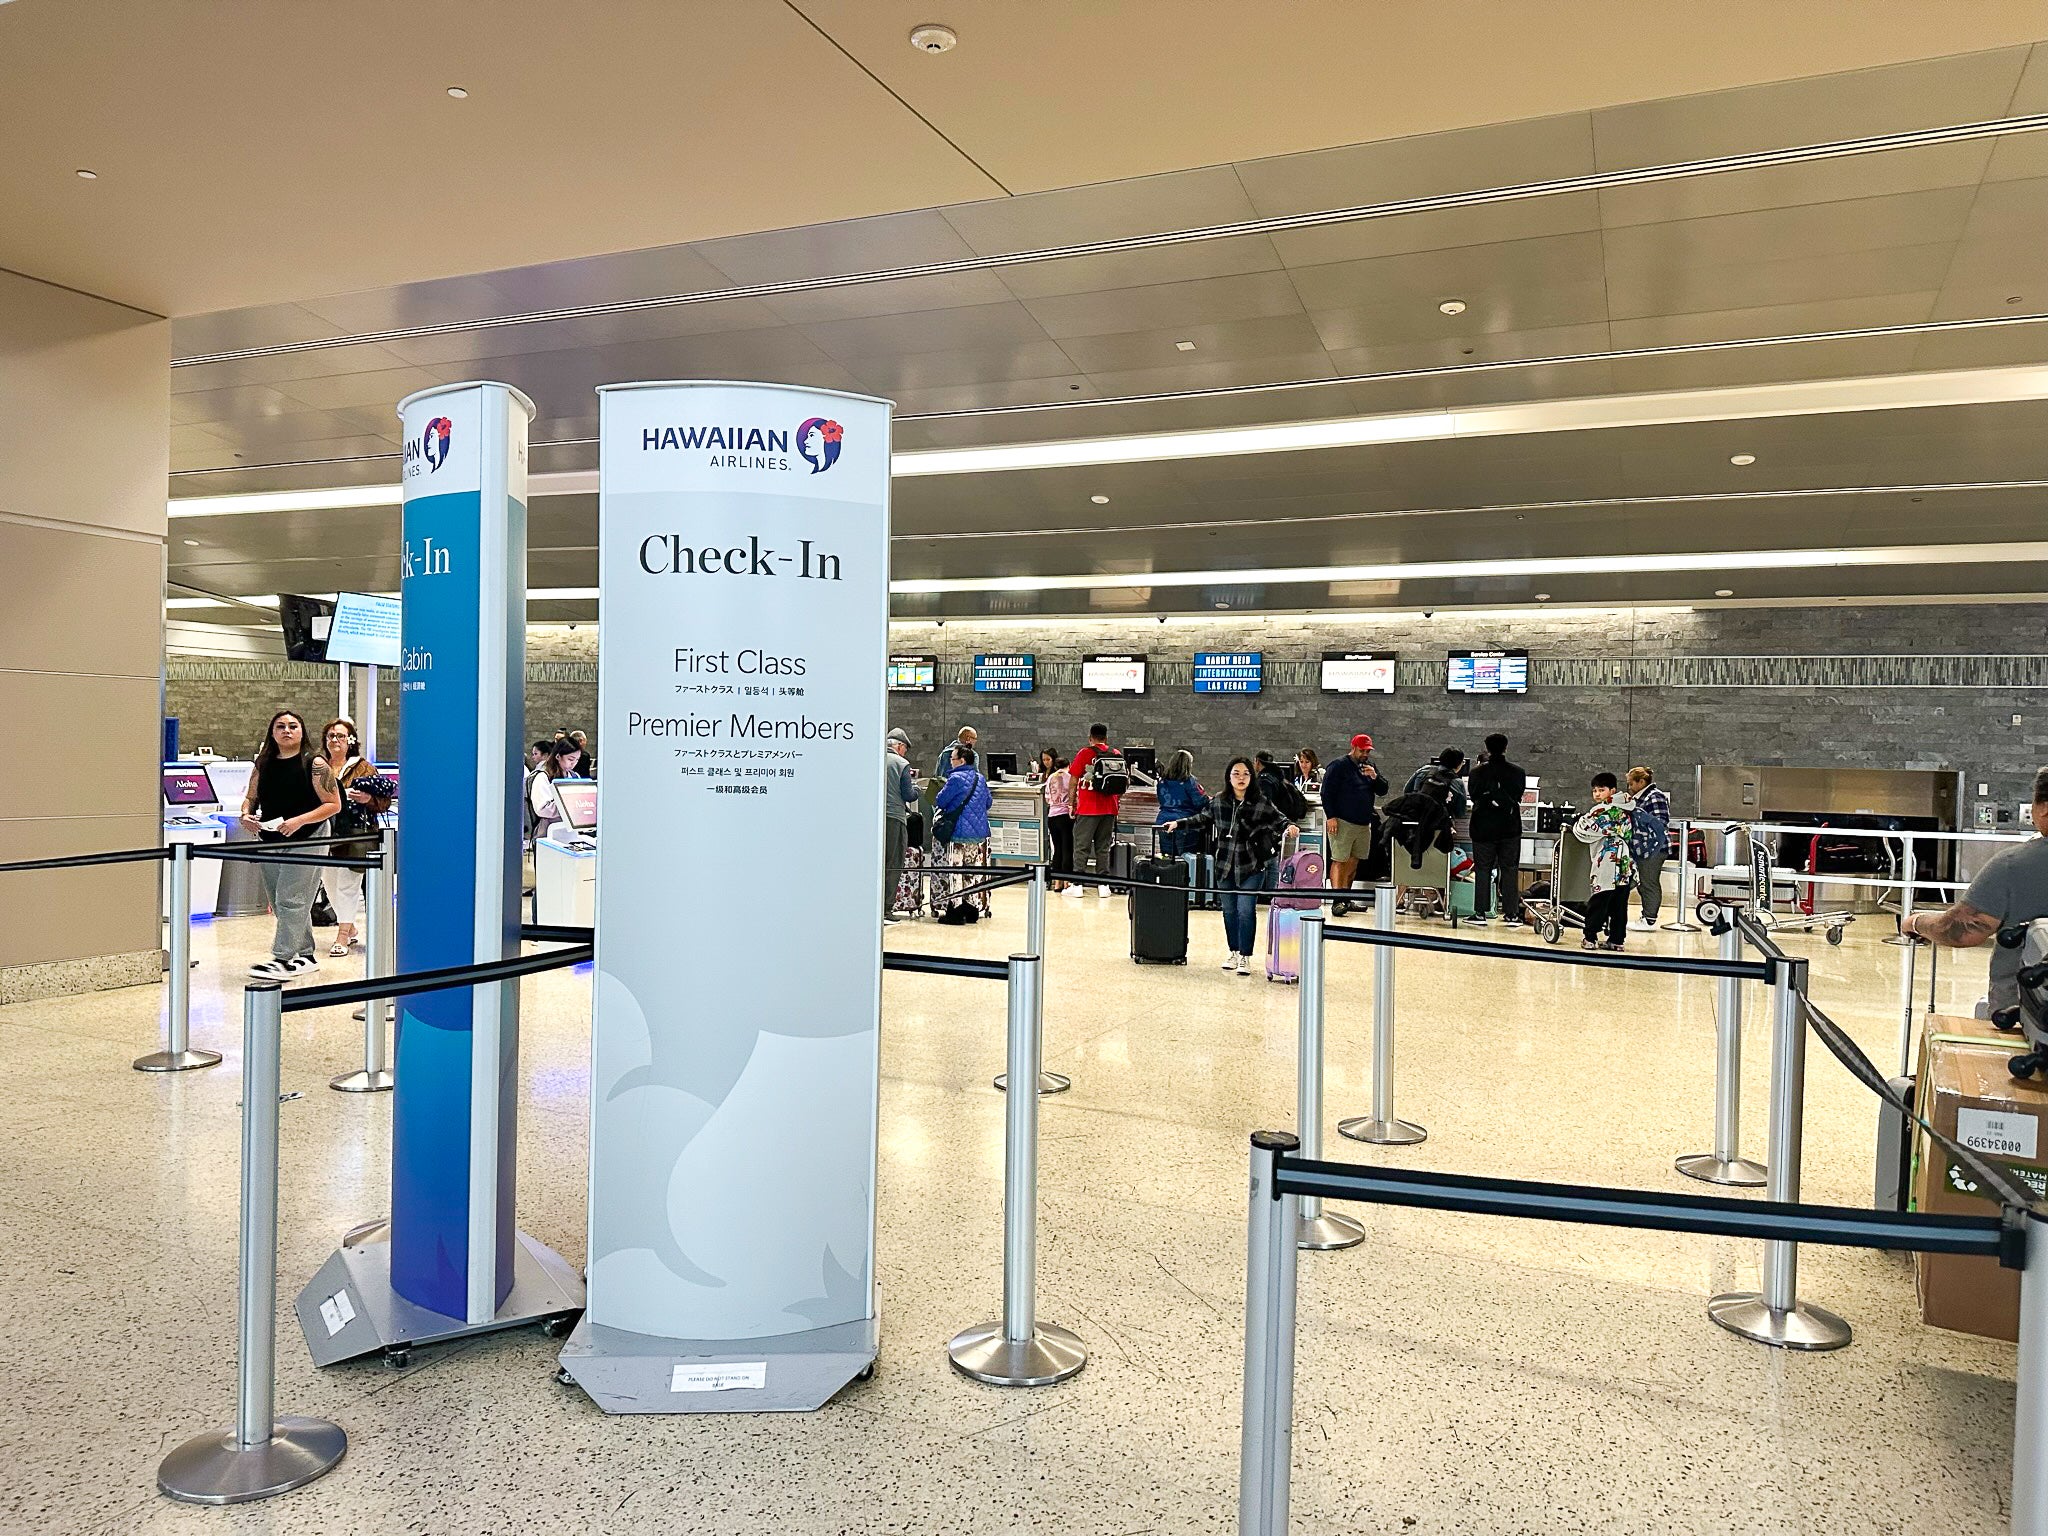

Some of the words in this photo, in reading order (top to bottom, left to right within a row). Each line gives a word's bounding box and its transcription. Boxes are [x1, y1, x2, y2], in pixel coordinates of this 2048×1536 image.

[642, 426, 788, 453] HAWAIIAN
[639, 534, 843, 581] Check-In
[401, 645, 433, 671] Cabin
[674, 647, 730, 674] First
[737, 649, 807, 676] Class
[1205, 656, 1231, 665] HARRY
[1232, 655, 1251, 665] REID
[978, 669, 1030, 678] INTERNATIONAL
[1199, 668, 1258, 678] INTERNATIONAL
[985, 681, 999, 690] LAS
[999, 681, 1021, 690] VEGAS
[1207, 681, 1221, 690] LAS
[1223, 681, 1248, 690] VEGAS
[744, 686, 769, 696] 일등석
[629, 711, 723, 738] Premier
[730, 713, 855, 740] Members
[575, 800, 595, 808] Aloha
[1967, 1136, 2021, 1152] 00034399
